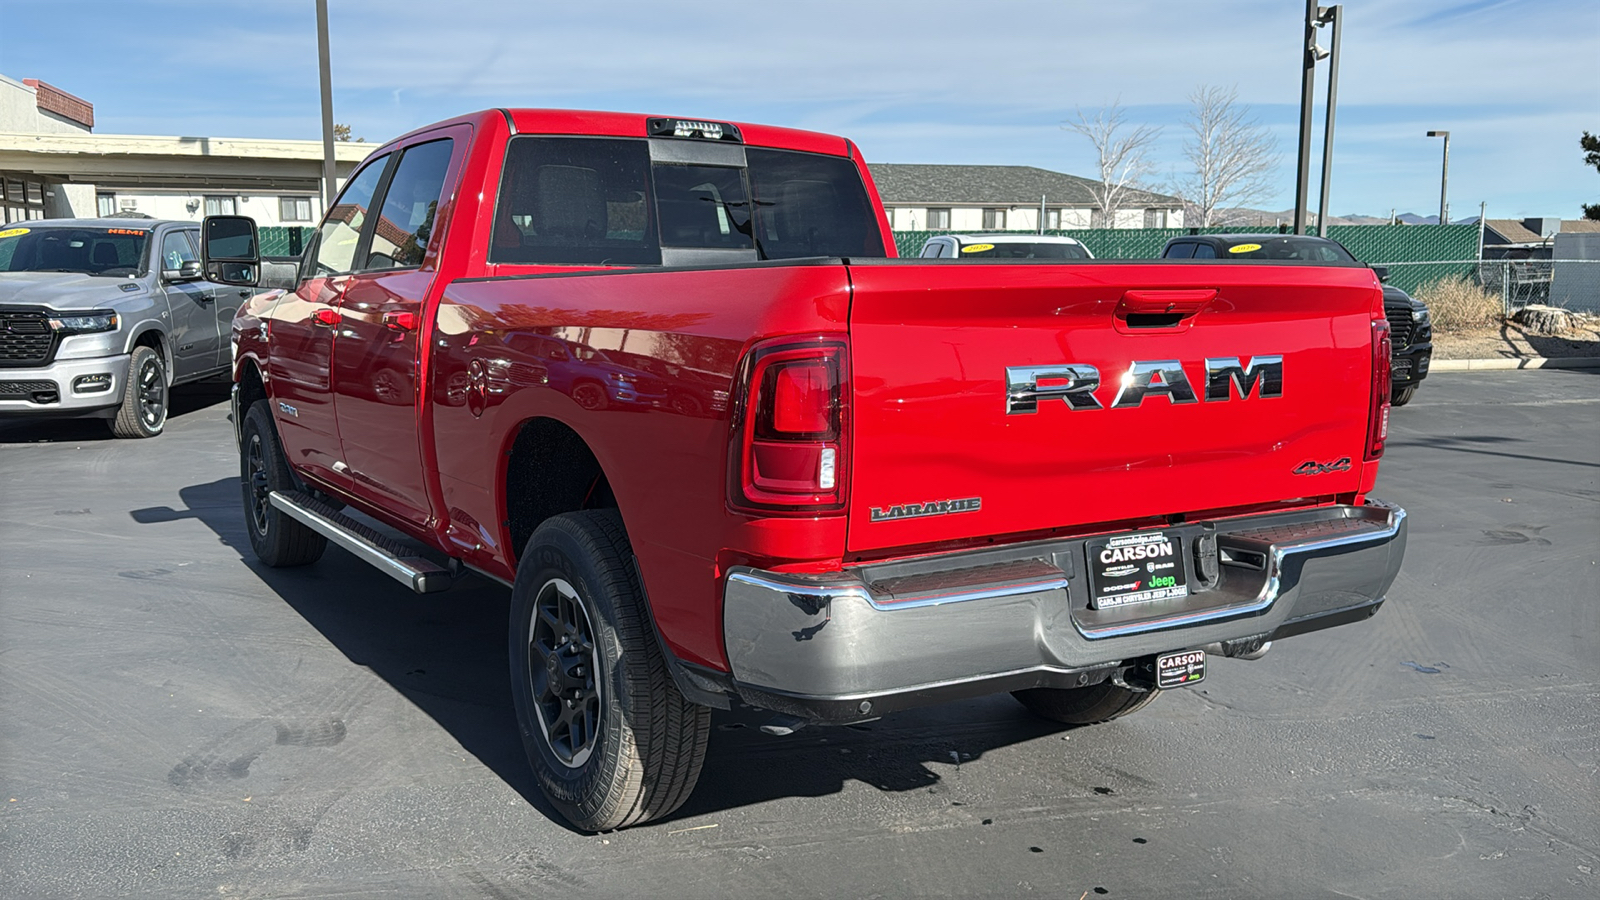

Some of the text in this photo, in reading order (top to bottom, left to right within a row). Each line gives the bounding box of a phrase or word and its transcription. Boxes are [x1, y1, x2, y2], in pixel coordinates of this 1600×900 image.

[1005, 354, 1284, 415] RAM
[869, 497, 982, 522] LARAMIE
[1100, 542, 1173, 564] CARSON
[1103, 583, 1137, 592] DODGE
[1148, 575, 1175, 587] Jeep
[1122, 592, 1152, 604] CHRYSLER
[1152, 590, 1167, 600] JEEP
[1160, 652, 1203, 668] CARSON
